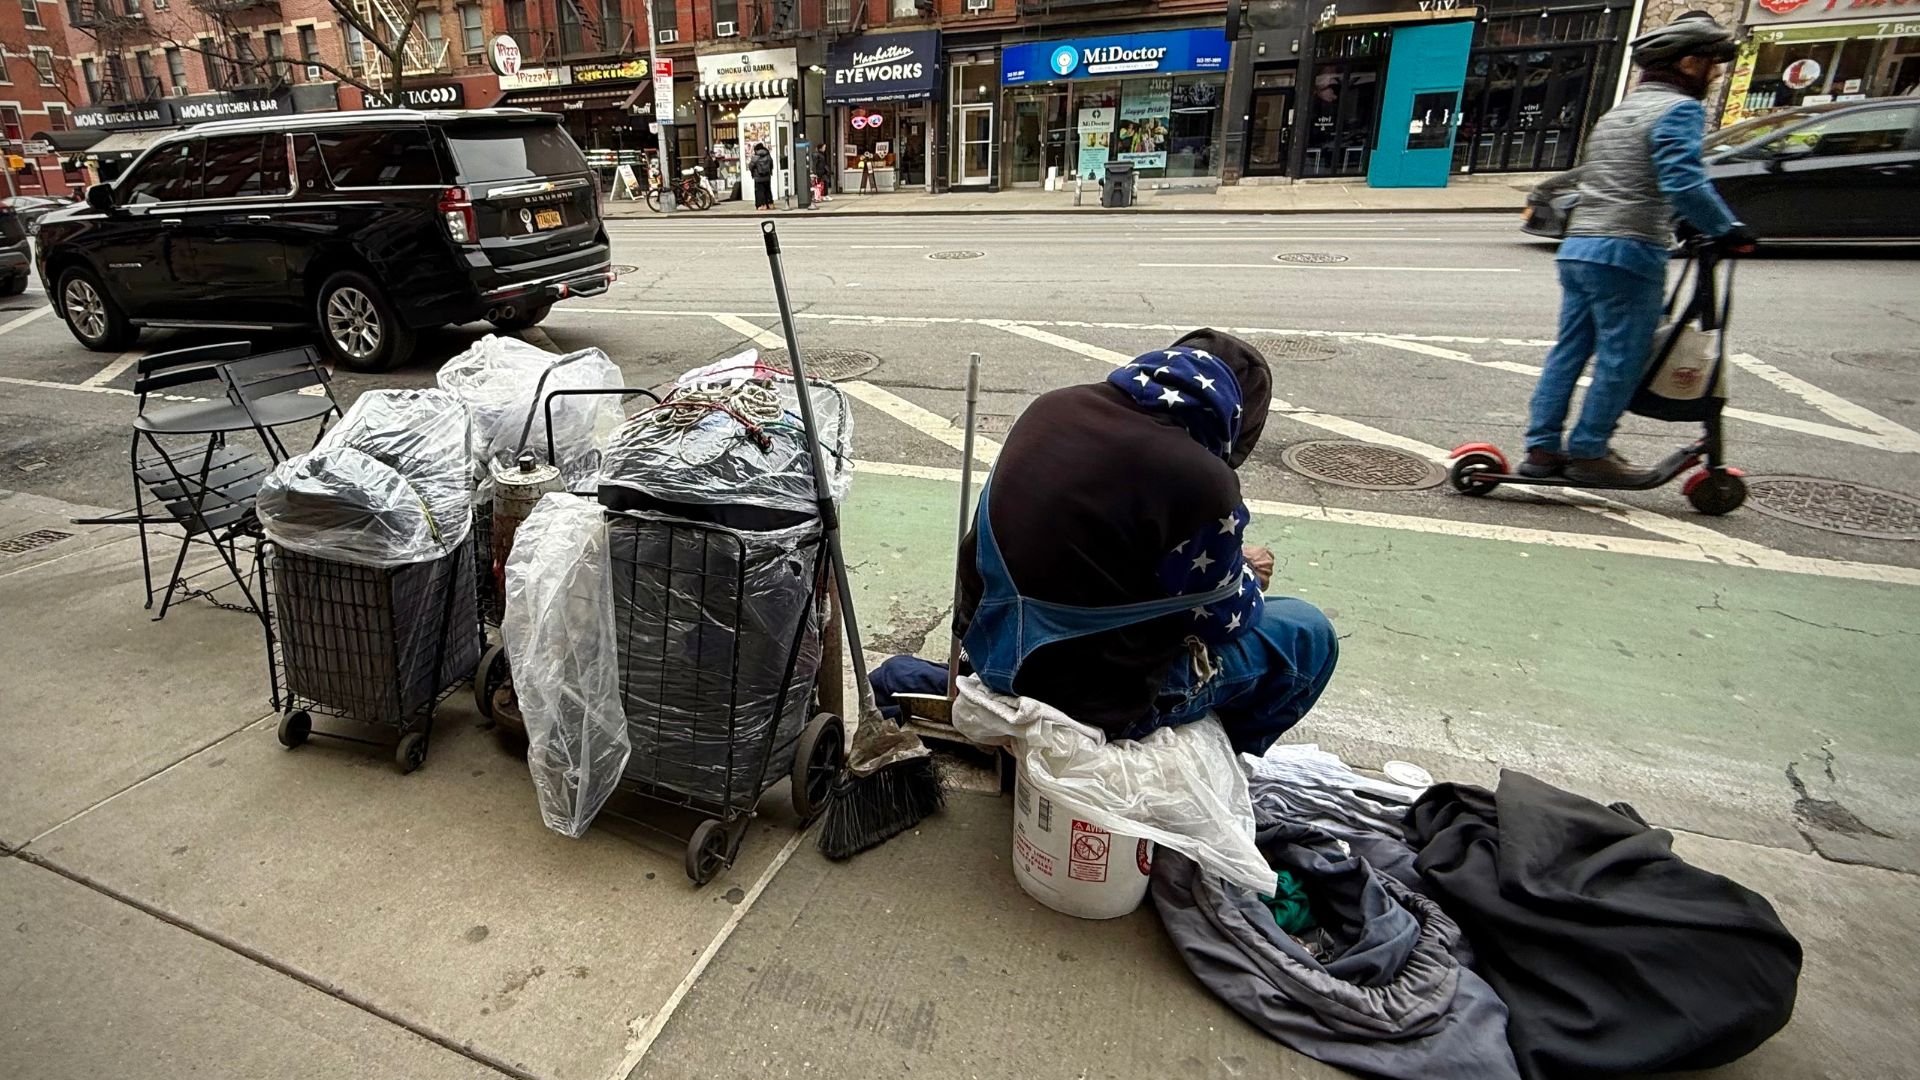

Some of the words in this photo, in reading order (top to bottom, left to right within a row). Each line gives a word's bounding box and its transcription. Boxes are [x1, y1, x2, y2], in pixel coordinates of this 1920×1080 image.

[852, 45, 912, 66] Manhattan
[578, 69, 625, 82] CHICKEN
[752, 64, 775, 72] RAMEN
[835, 63, 923, 84] EYEWORKS
[181, 103, 215, 119] MOM'S
[216, 102, 250, 115] KITCHEN
[252, 101, 259, 112] &
[260, 99, 278, 112] BAR
[74, 113, 105, 127] MOM'S
[105, 112, 136, 123] KITCHEN
[137, 111, 144, 121] &
[144, 110, 160, 121] BAR
